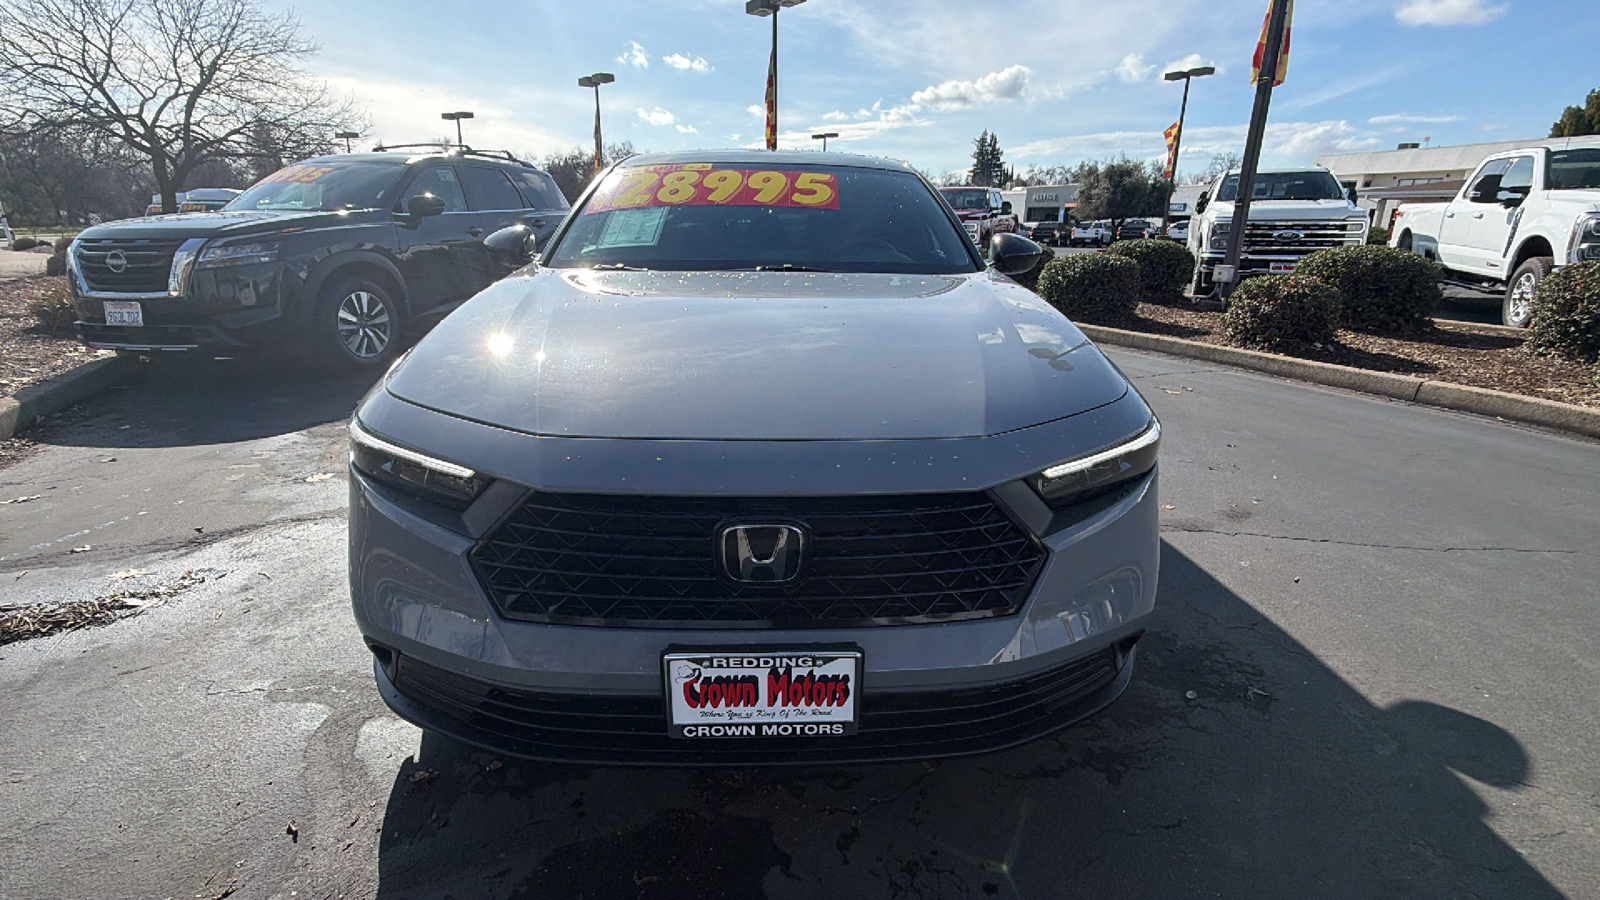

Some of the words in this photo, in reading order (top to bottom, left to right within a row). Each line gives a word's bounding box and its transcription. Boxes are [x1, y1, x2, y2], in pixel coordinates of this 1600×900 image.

[712, 657, 813, 668] REDDING
[683, 668, 759, 708] Crown
[767, 667, 850, 708] Motors
[700, 710, 724, 718] Where
[756, 709, 775, 719] King
[779, 709, 791, 719] Of
[793, 709, 807, 717] The
[810, 708, 833, 717] Road
[683, 725, 756, 737] CROWN
[762, 724, 844, 736] MOTORS
